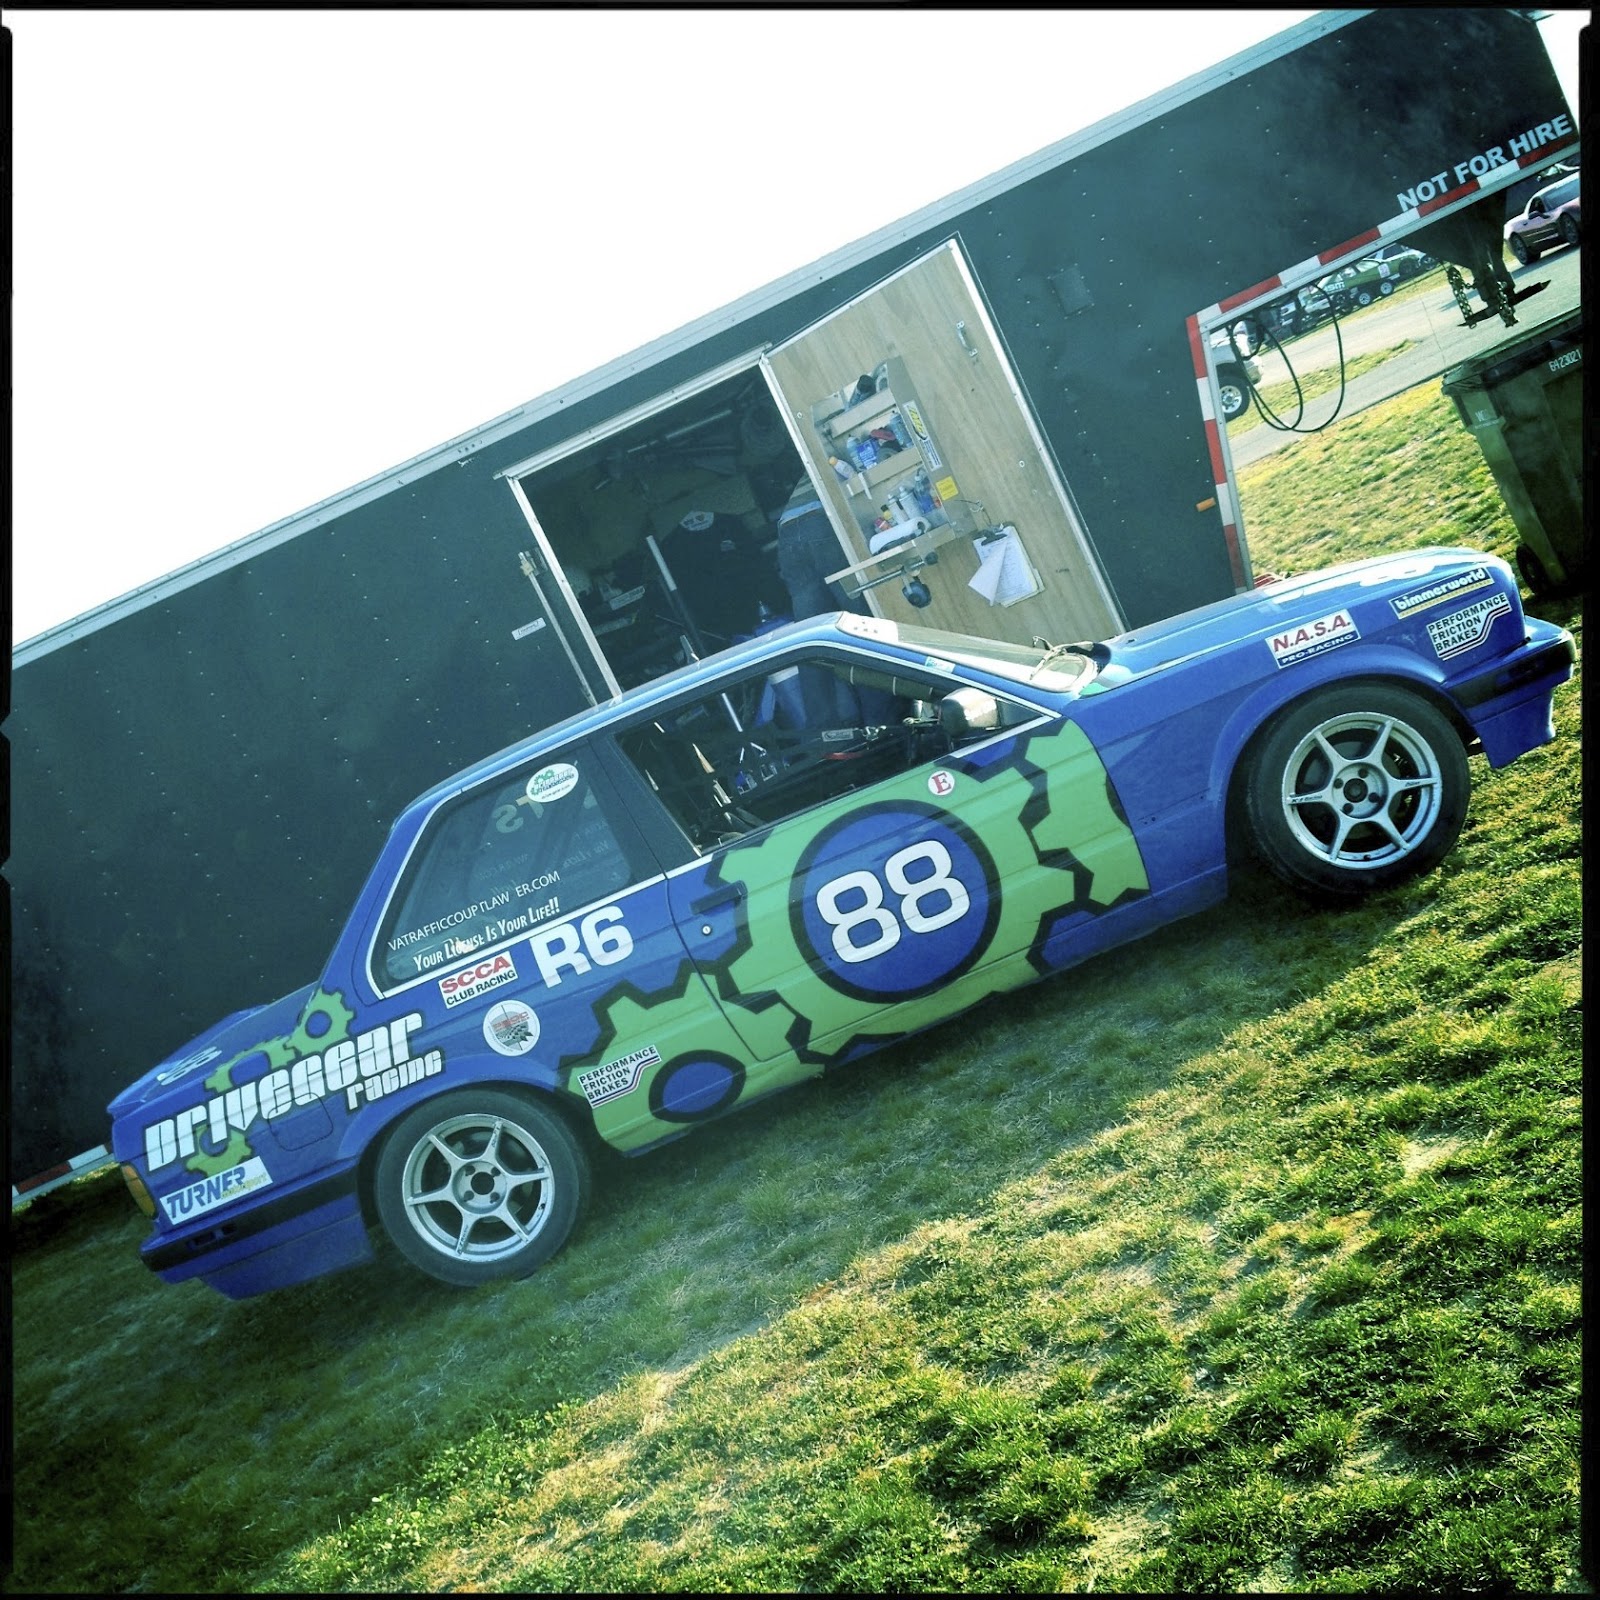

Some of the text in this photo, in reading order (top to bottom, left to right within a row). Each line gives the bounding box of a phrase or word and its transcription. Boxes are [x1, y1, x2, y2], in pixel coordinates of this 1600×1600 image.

[1397, 113, 1573, 212] NOT FOR HIRE
[1394, 568, 1486, 610] bimmerworld
[1428, 594, 1507, 633] PERFORMANCE
[1432, 616, 1482, 643] FRICTION
[1273, 614, 1351, 652] N.A.S.A.
[1435, 627, 1479, 652] BRAKES
[931, 772, 952, 794] E
[816, 840, 970, 963] 88
[529, 906, 634, 988] R6
[441, 955, 511, 995] SCCA
[446, 969, 516, 1006] CLUB RACING
[579, 1046, 656, 1084] PERFORMANCE
[583, 1067, 631, 1092] FRICTION
[587, 1078, 629, 1100] BRAKES
[167, 1166, 245, 1219] TURNER
